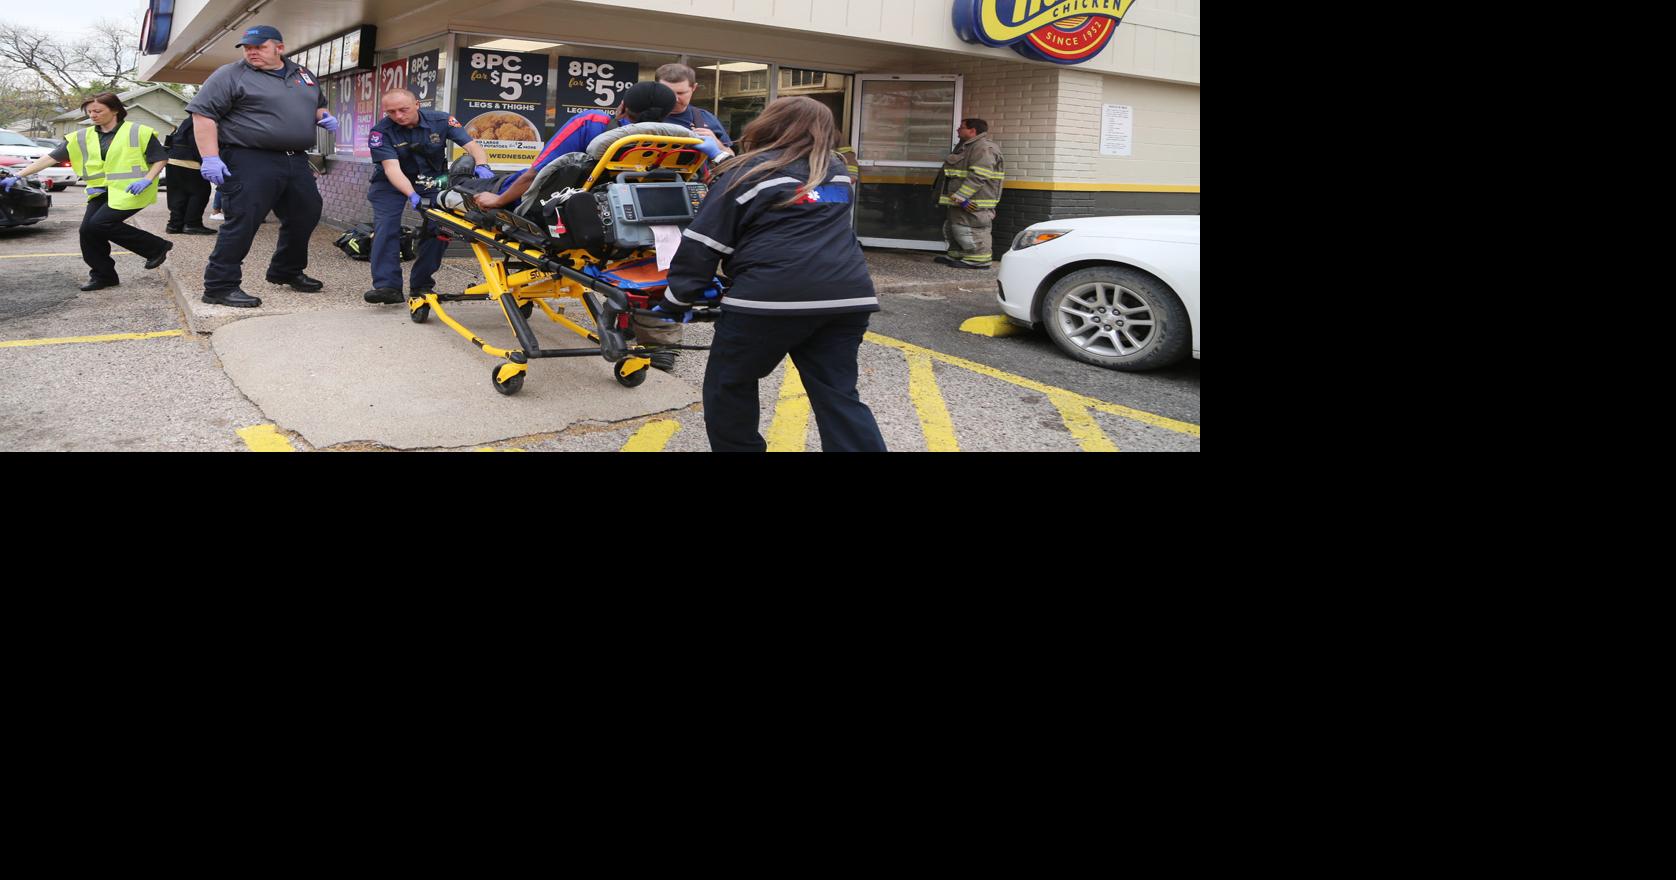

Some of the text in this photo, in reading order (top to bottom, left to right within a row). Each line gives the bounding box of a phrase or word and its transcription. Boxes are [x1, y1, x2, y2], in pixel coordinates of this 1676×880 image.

[1053, 0, 1120, 17] CHICKEN
[1046, 21, 1102, 46] SINCE 1952
[411, 55, 430, 73] 8PC
[471, 52, 522, 72] 8PC
[568, 60, 615, 79] 8PC
[471, 70, 488, 81] for
[568, 77, 584, 88] for
[469, 101, 493, 109] LEGS
[502, 103, 535, 111] THIGHS
